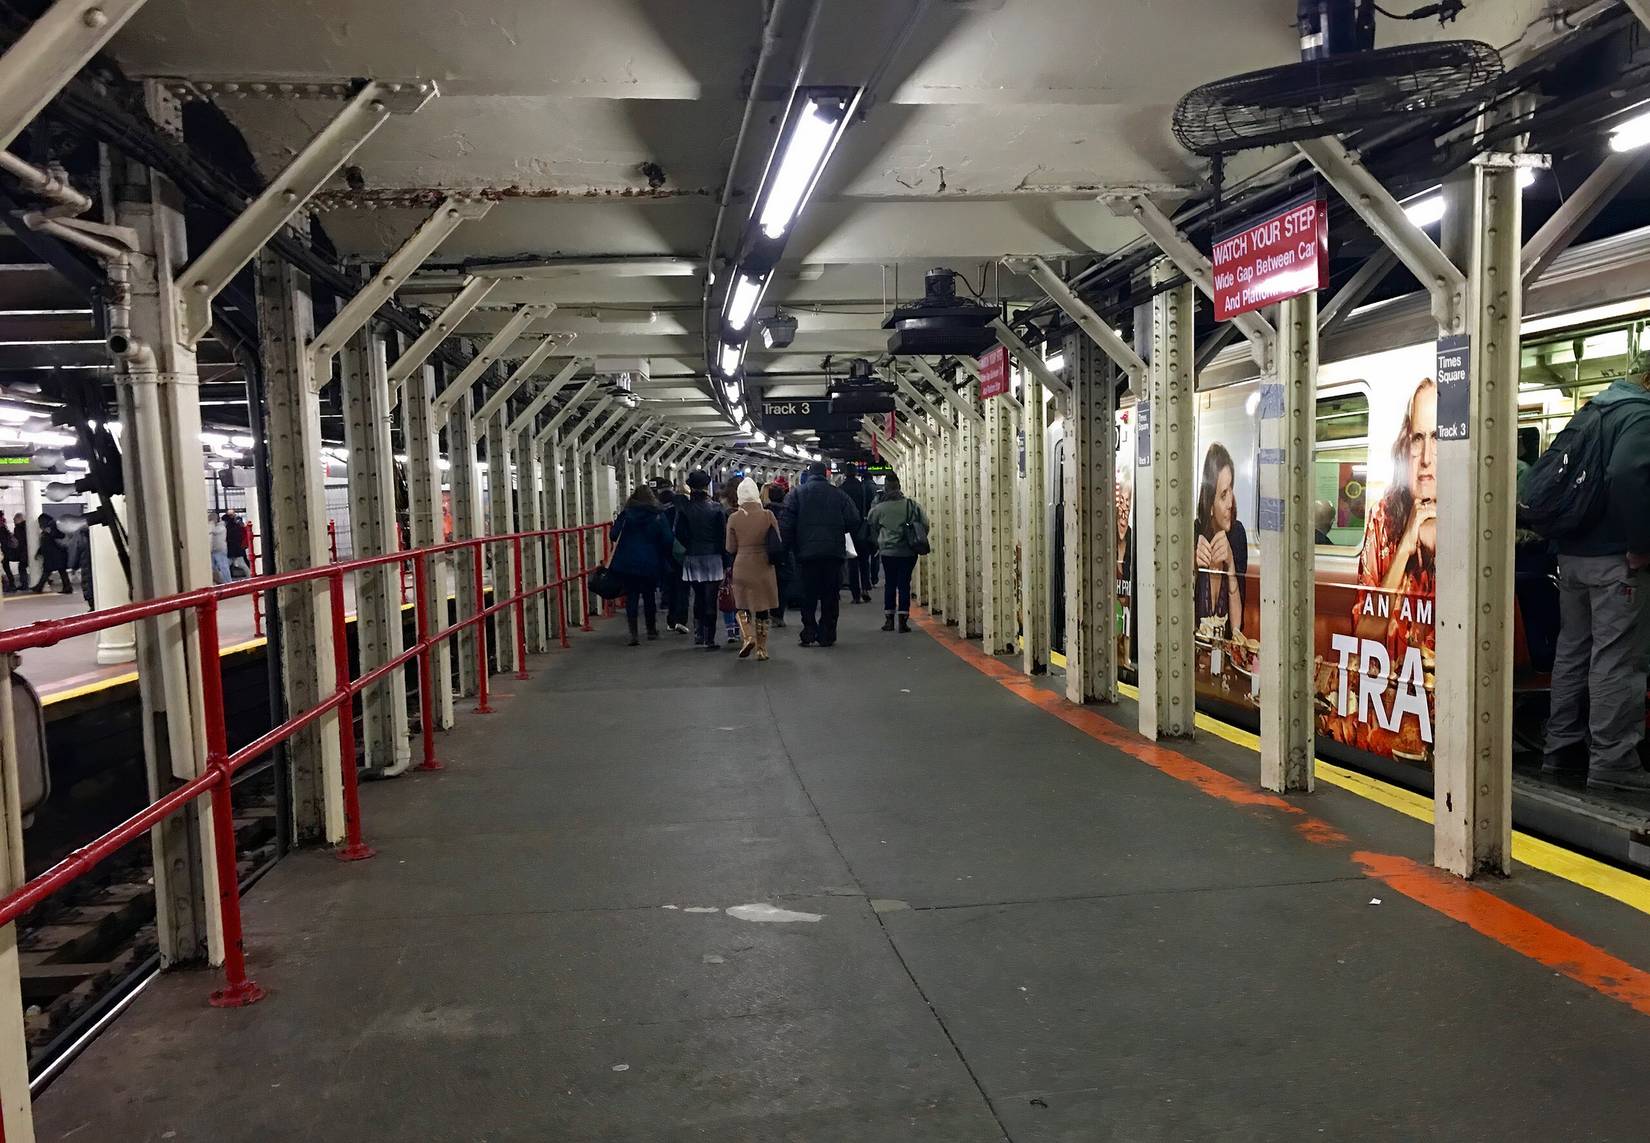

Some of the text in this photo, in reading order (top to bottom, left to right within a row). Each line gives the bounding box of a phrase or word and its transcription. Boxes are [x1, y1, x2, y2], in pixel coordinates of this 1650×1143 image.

[1213, 206, 1315, 266] WATCH YOUR STEP
[1215, 241, 1315, 291] Wide Gap Between Car
[1225, 292, 1240, 312] And
[1438, 356, 1462, 369] Times
[1438, 370, 1466, 384] Square
[763, 402, 810, 414] Track 3
[1438, 423, 1466, 437] Track 3
[1363, 593, 1432, 625] AN AM
[1332, 633, 1433, 743] TRA
